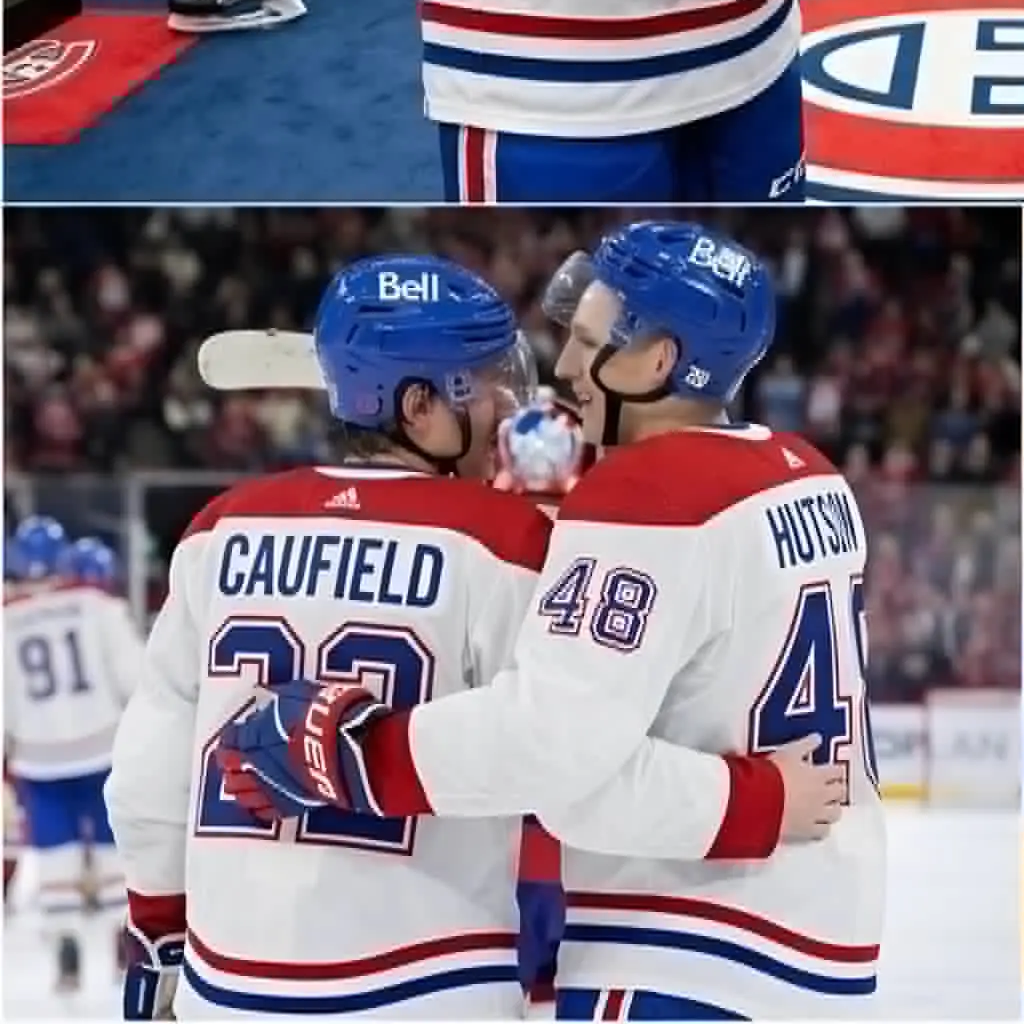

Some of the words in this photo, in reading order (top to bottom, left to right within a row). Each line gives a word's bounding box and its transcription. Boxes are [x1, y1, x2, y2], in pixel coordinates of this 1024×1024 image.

[379, 272, 439, 302] Bell
[219, 533, 444, 608] CAUFIELD
[538, 558, 655, 655] 48
[17, 628, 94, 702] 91
[748, 573, 882, 806] 4
[194, 615, 435, 856] 22
